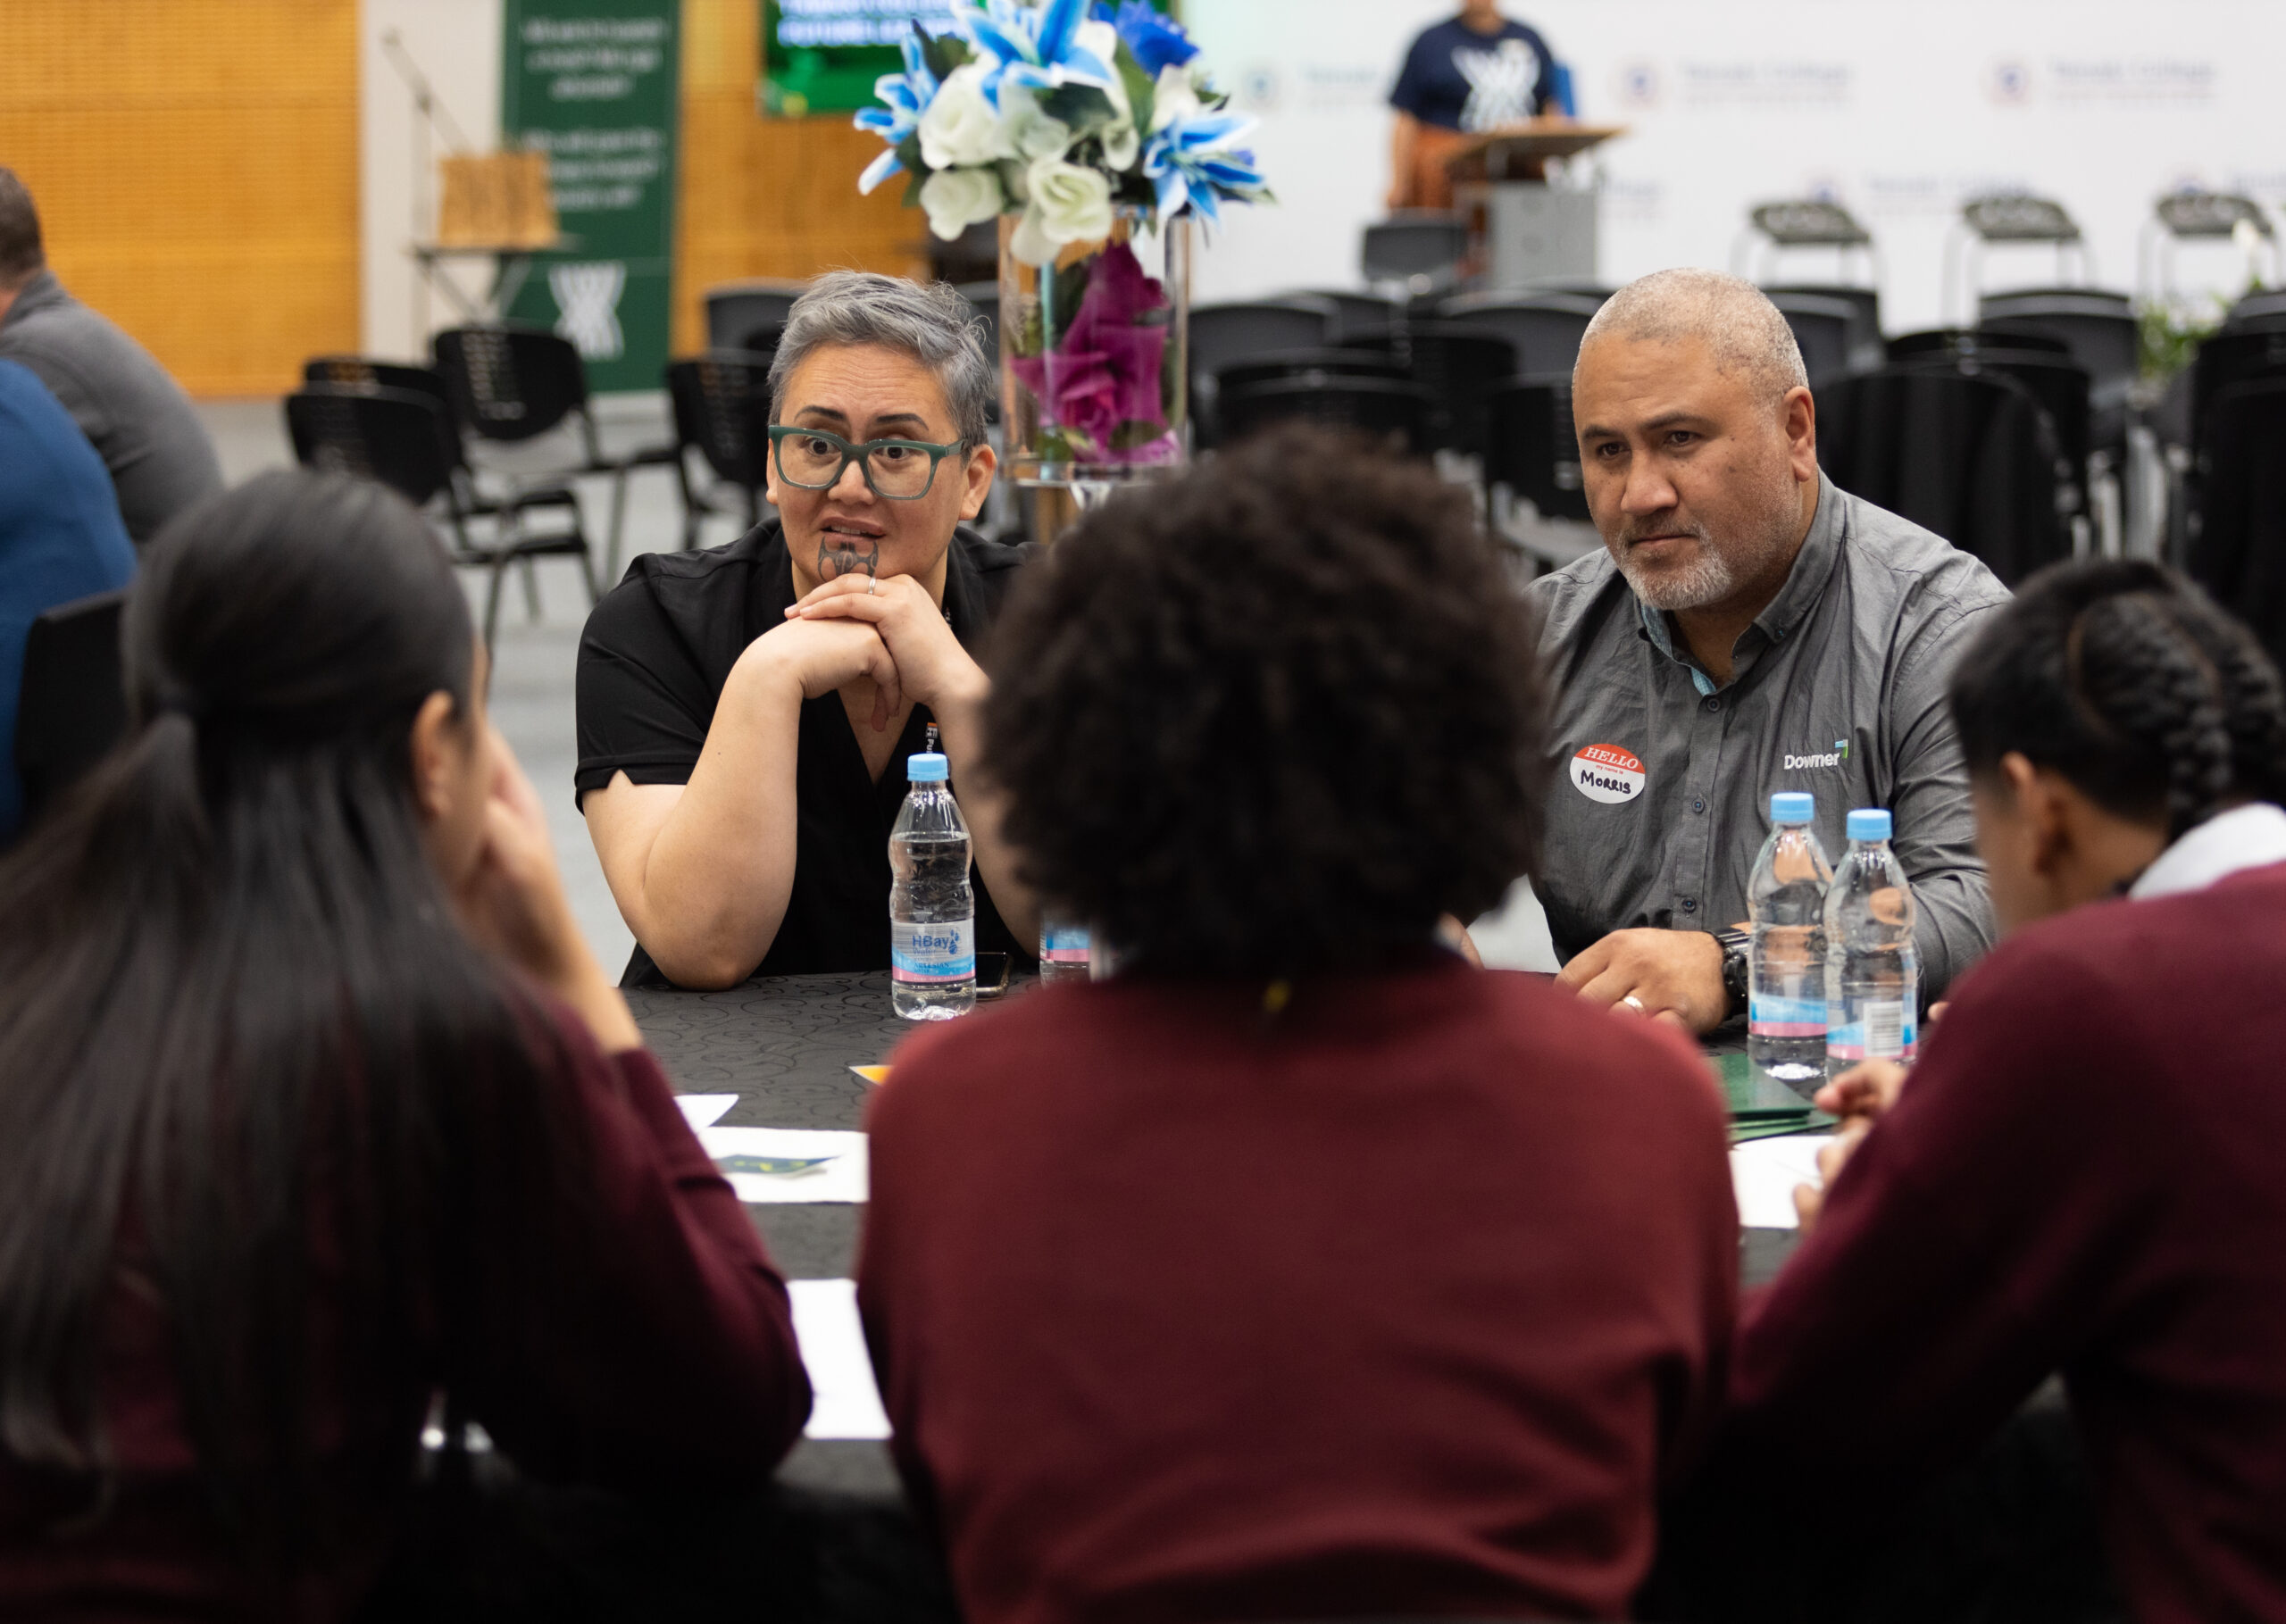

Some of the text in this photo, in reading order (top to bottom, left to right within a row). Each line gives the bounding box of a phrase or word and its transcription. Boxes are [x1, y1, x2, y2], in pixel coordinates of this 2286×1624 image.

[1584, 747, 1638, 769] HELLO
[1783, 753, 1840, 770] Downer
[912, 935, 948, 949] HBay
